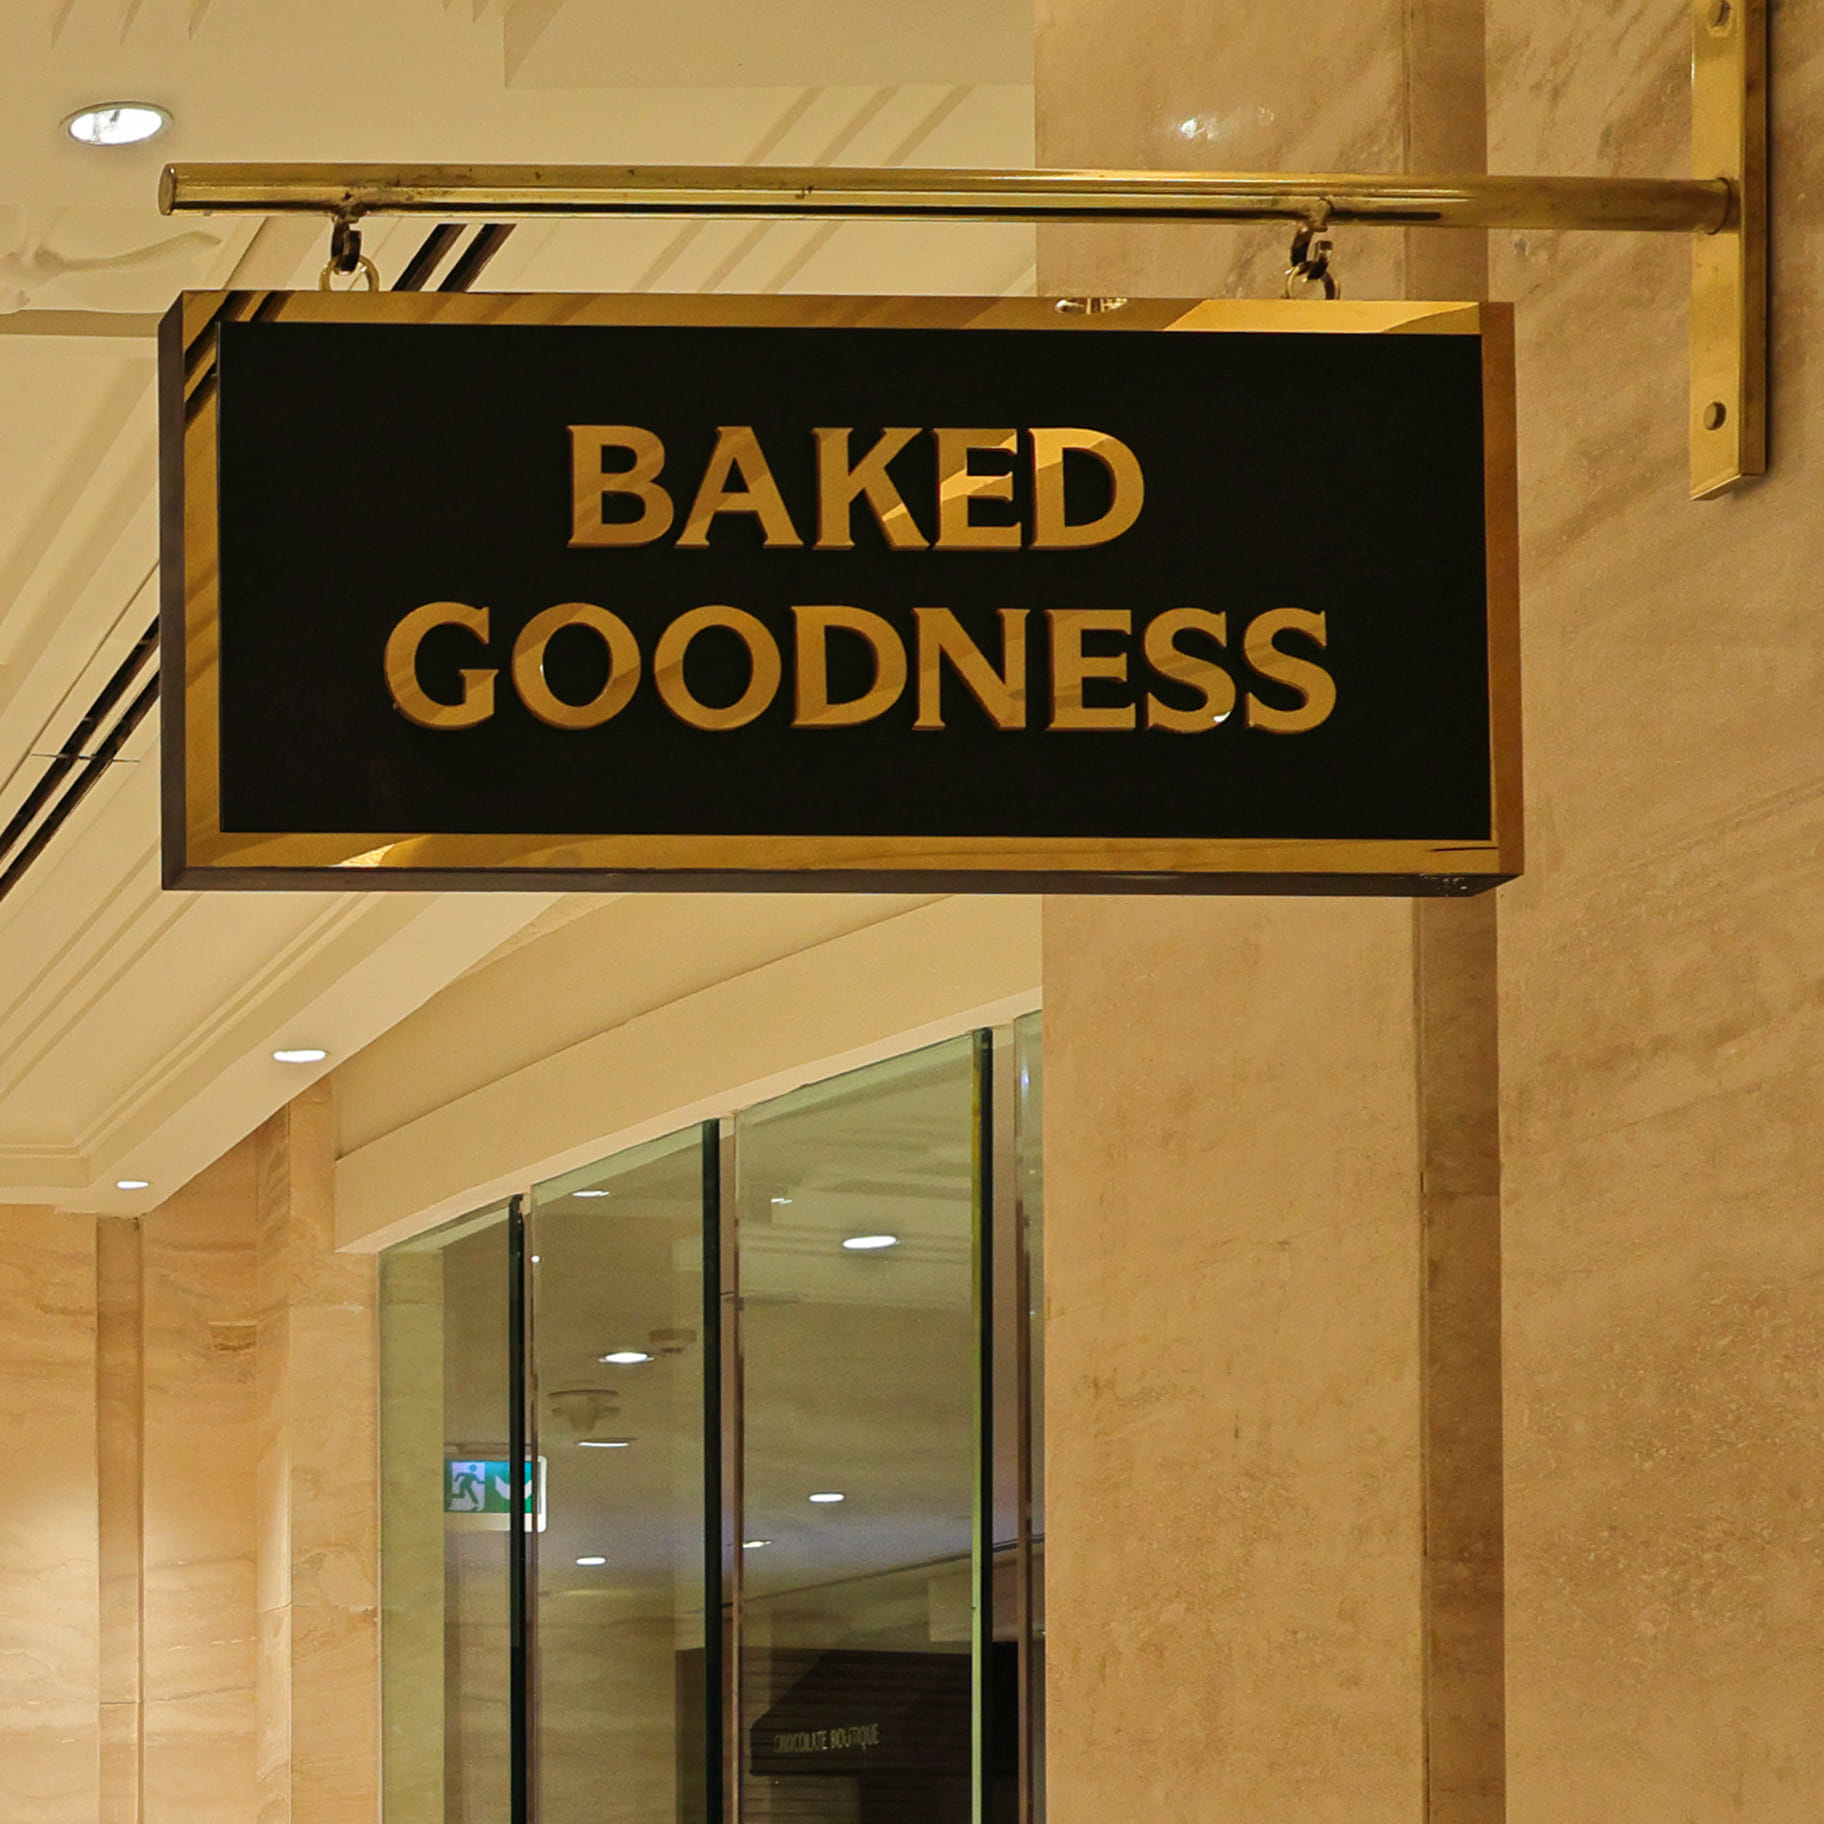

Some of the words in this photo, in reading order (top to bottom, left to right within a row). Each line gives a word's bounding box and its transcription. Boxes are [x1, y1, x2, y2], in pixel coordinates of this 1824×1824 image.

[566, 423, 1145, 552] BAKED
[382, 601, 1338, 734] GOODNESS
[774, 1731, 828, 1753] CHOCOLATE
[830, 1723, 880, 1750] BOUTIQUE
